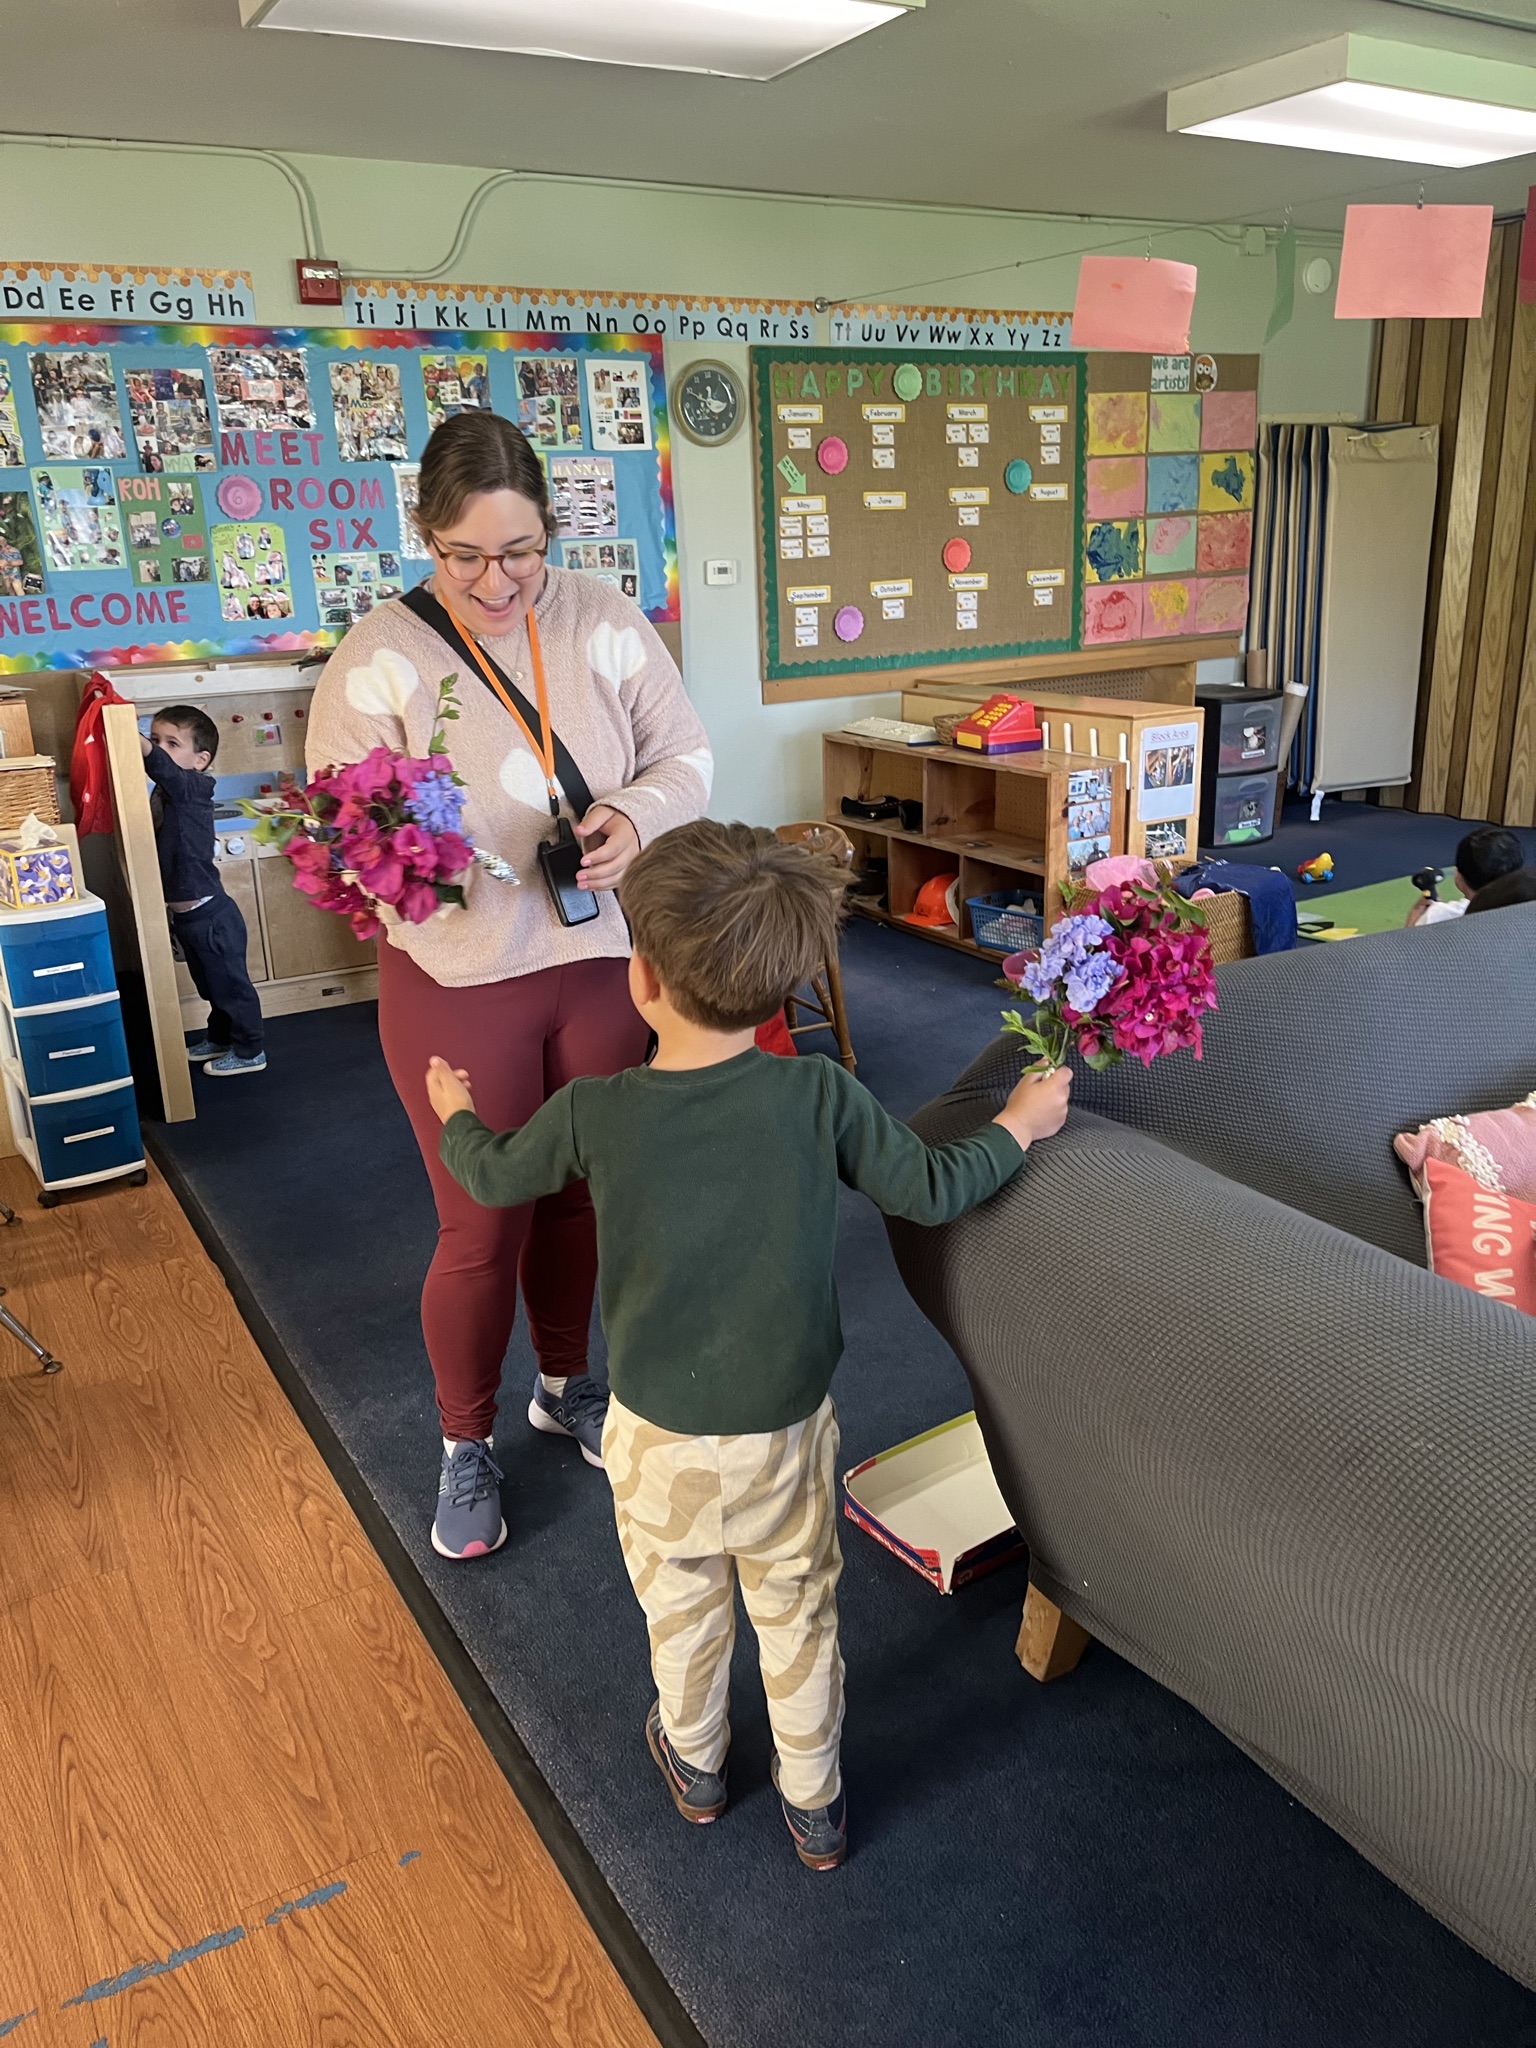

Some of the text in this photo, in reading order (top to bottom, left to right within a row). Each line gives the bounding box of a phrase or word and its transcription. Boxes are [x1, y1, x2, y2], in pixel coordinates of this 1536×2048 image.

[3, 286, 244, 321] Dd Ee Ff Gg Hh
[355, 302, 809, 342] Ii Jj Kk Ll Mm Nn Oo Pp Qq Rr Ss
[834, 322, 1062, 350] Tt Uu Vv Ww Xx Yy Zz
[1152, 358, 1190, 371] we are
[773, 368, 1072, 399] HAPPY BIRTHDAY
[1150, 374, 1190, 391] artists!
[787, 409, 813, 418] January
[870, 409, 898, 418] February
[221, 432, 324, 466] MEET
[268, 477, 386, 511] ROOM
[963, 492, 975, 501] July
[1040, 488, 1059, 496] August
[878, 497, 892, 505] June
[309, 517, 378, 551] SIX
[1033, 574, 1060, 583] December
[792, 591, 826, 600] September
[880, 585, 904, 593] October
[1472, 1182, 1513, 1257] ING
